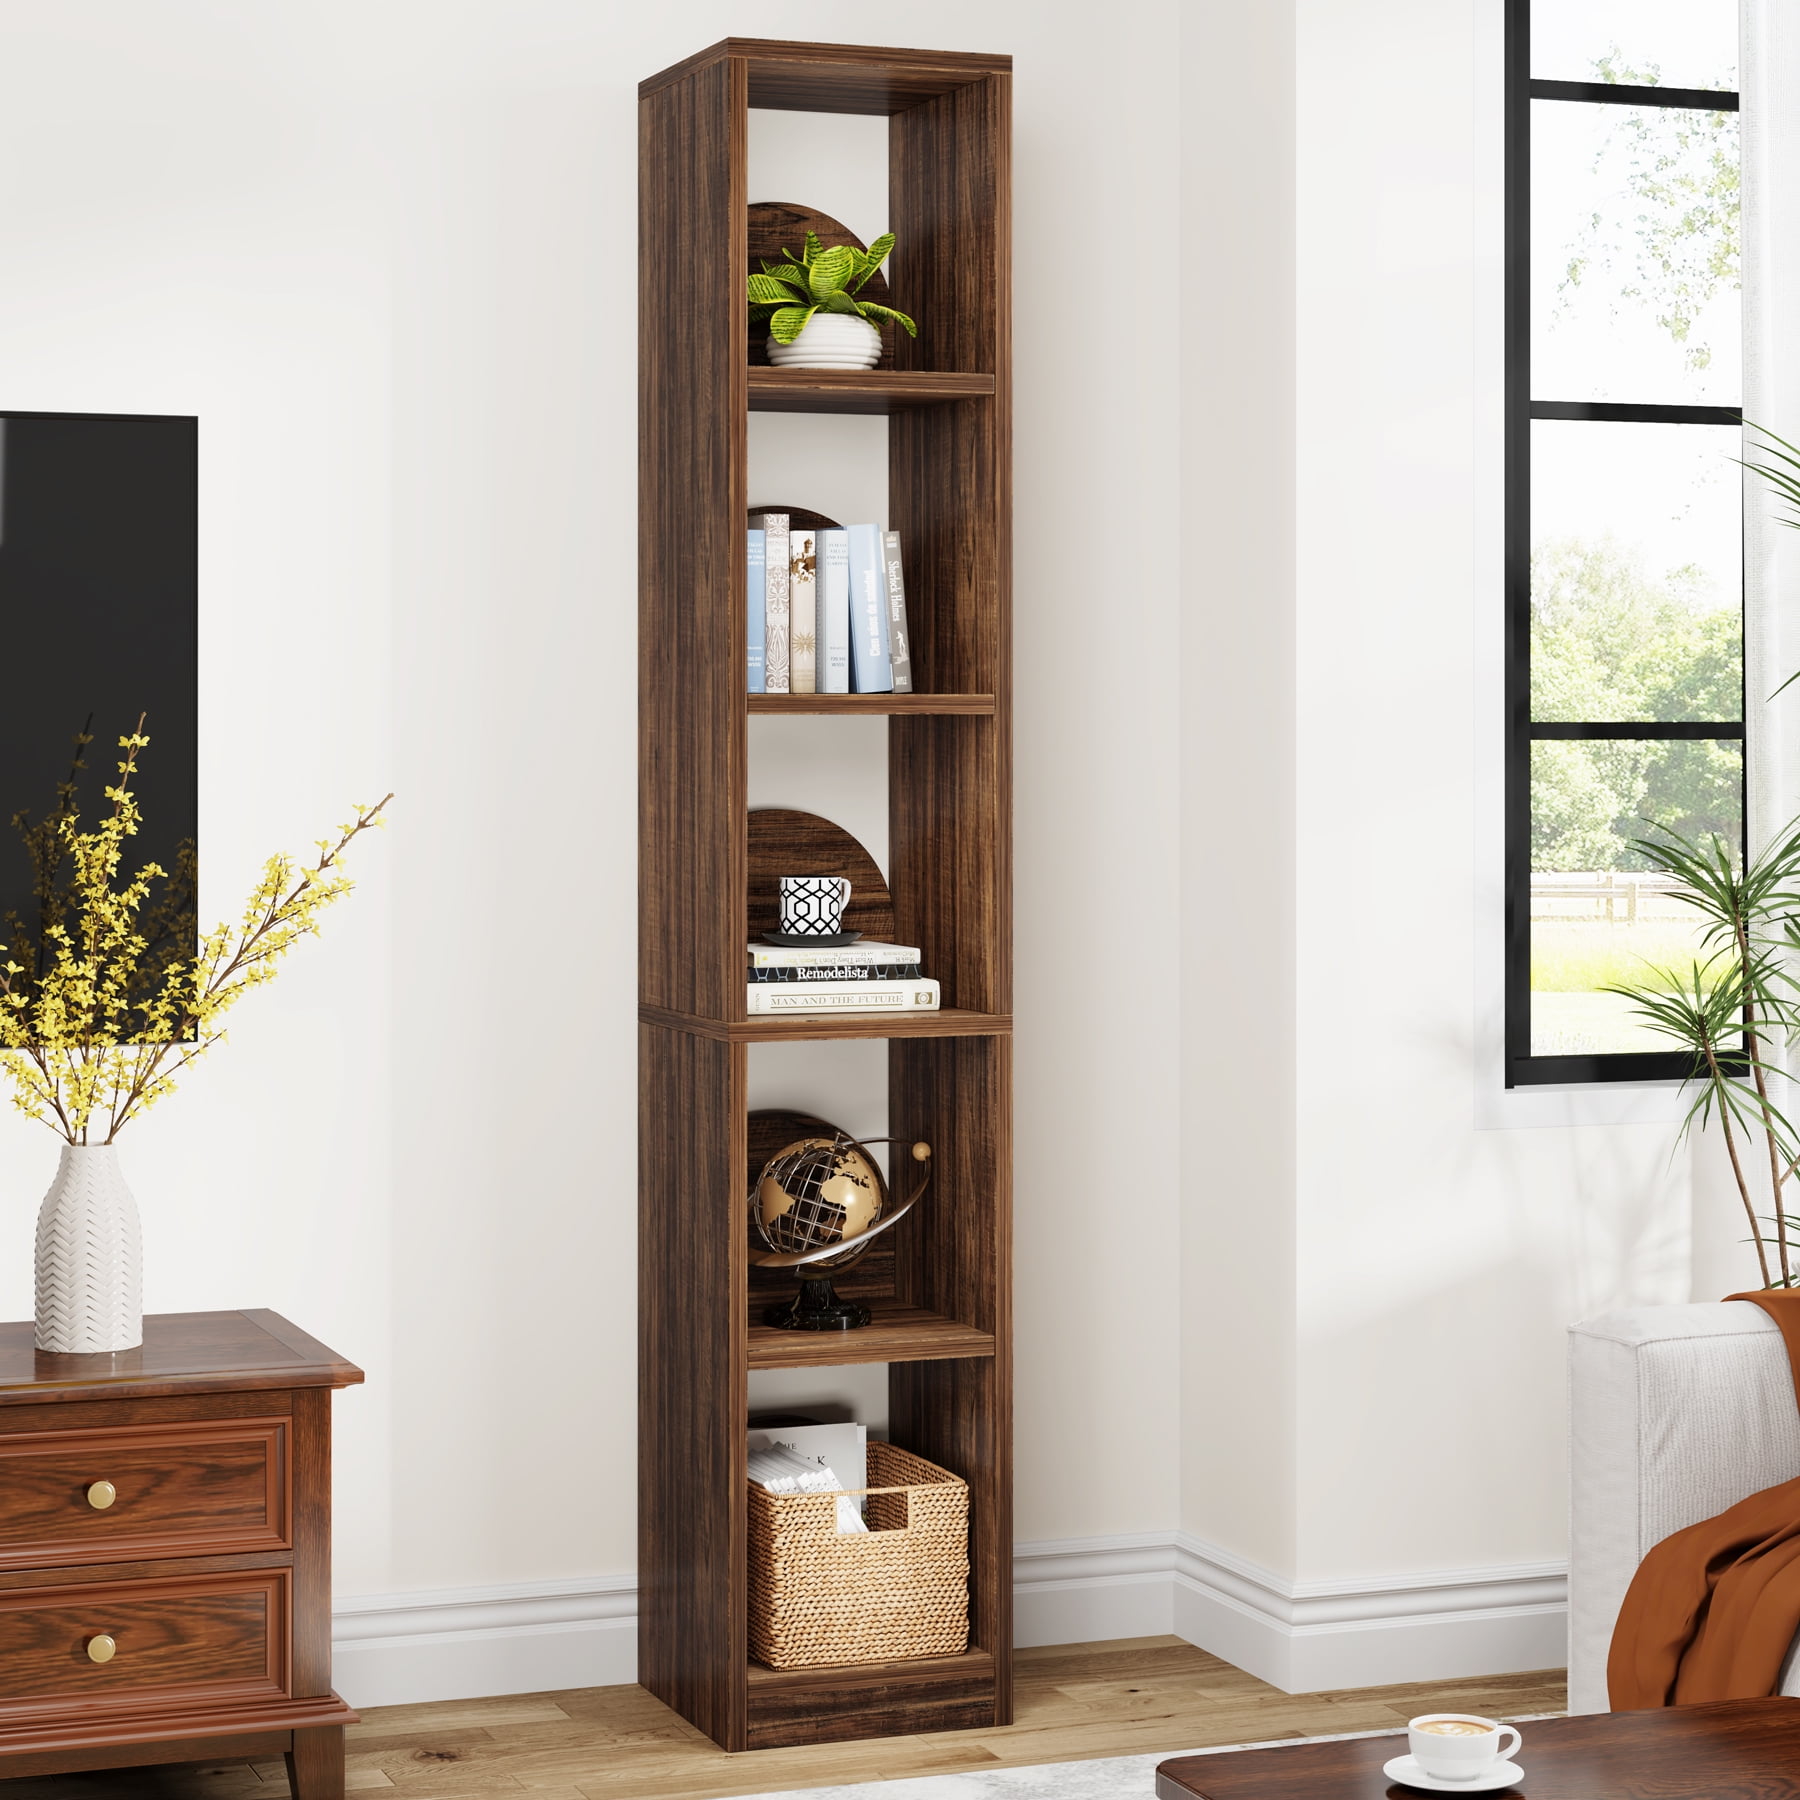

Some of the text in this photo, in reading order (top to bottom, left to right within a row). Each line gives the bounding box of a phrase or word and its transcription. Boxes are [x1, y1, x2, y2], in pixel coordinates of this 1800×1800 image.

[888, 560, 902, 622] Sherlock Holmes
[797, 966, 869, 979] Remodelista
[771, 995, 903, 1006] MAN AND THE FUTURE
